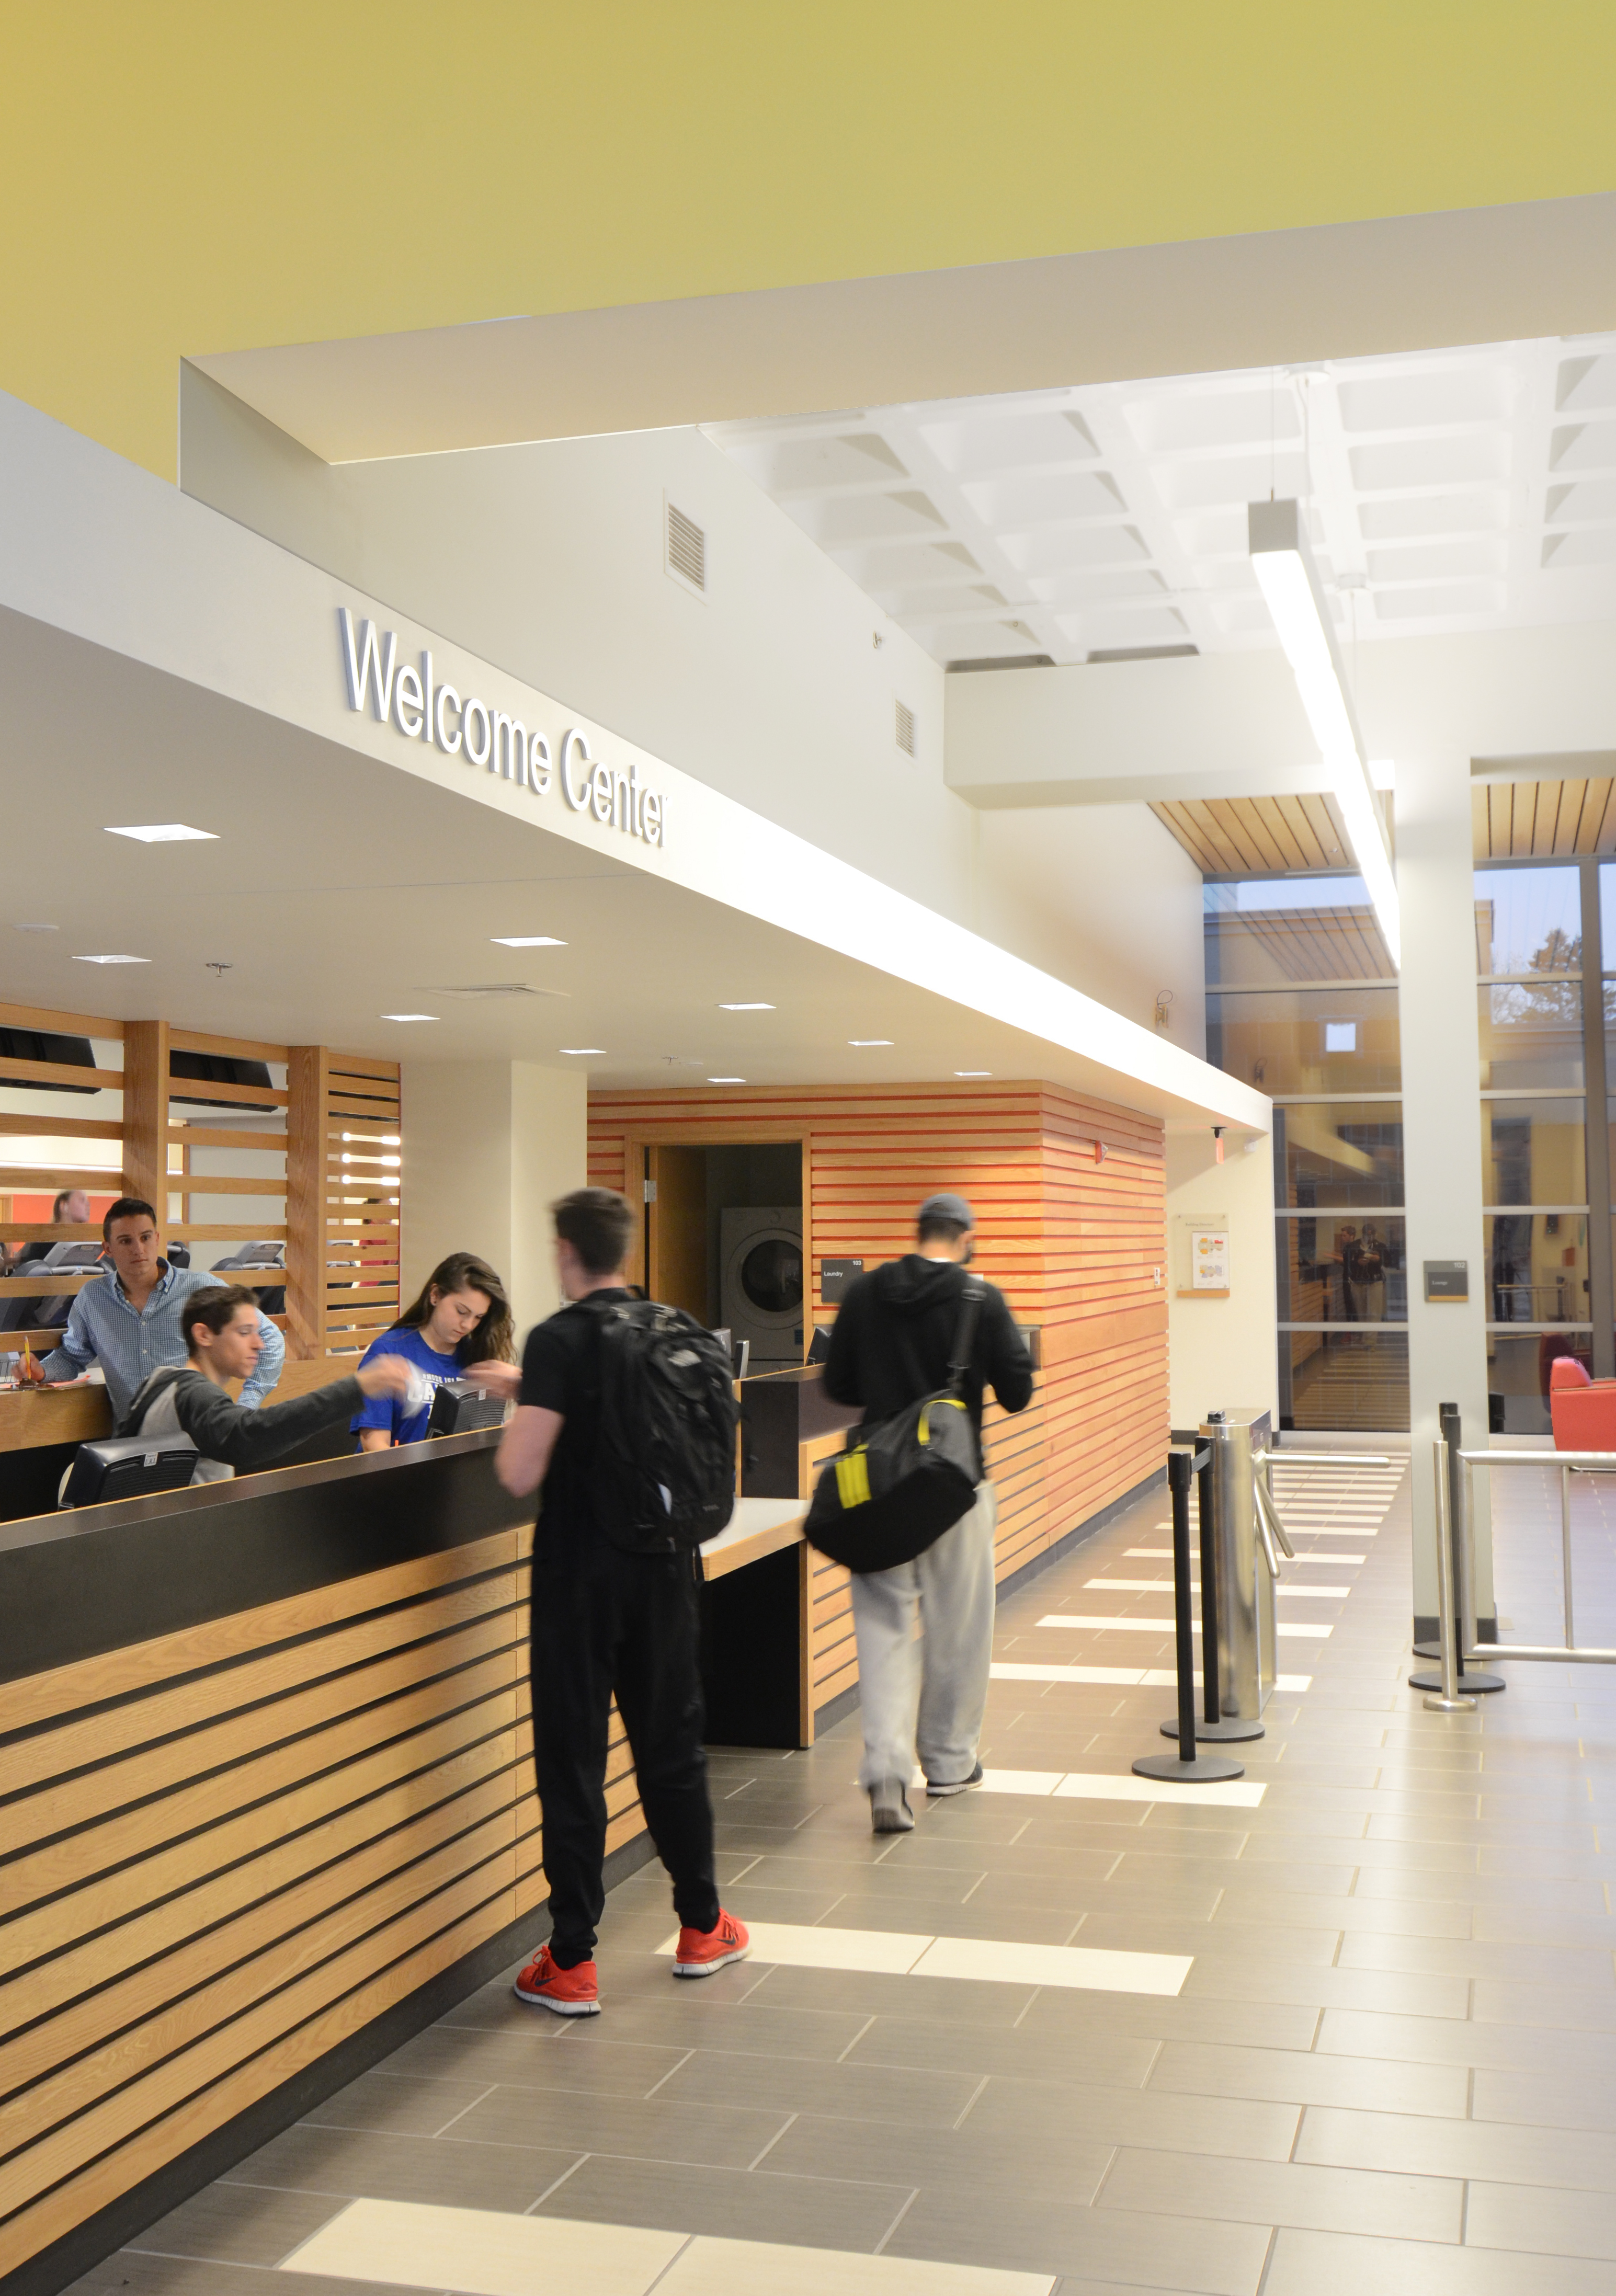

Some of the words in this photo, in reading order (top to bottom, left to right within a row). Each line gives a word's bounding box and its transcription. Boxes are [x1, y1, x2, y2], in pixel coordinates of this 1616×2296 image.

[339, 607, 553, 795] Welcome
[561, 727, 671, 848] Center
[423, 1374, 443, 1384] RHODE
